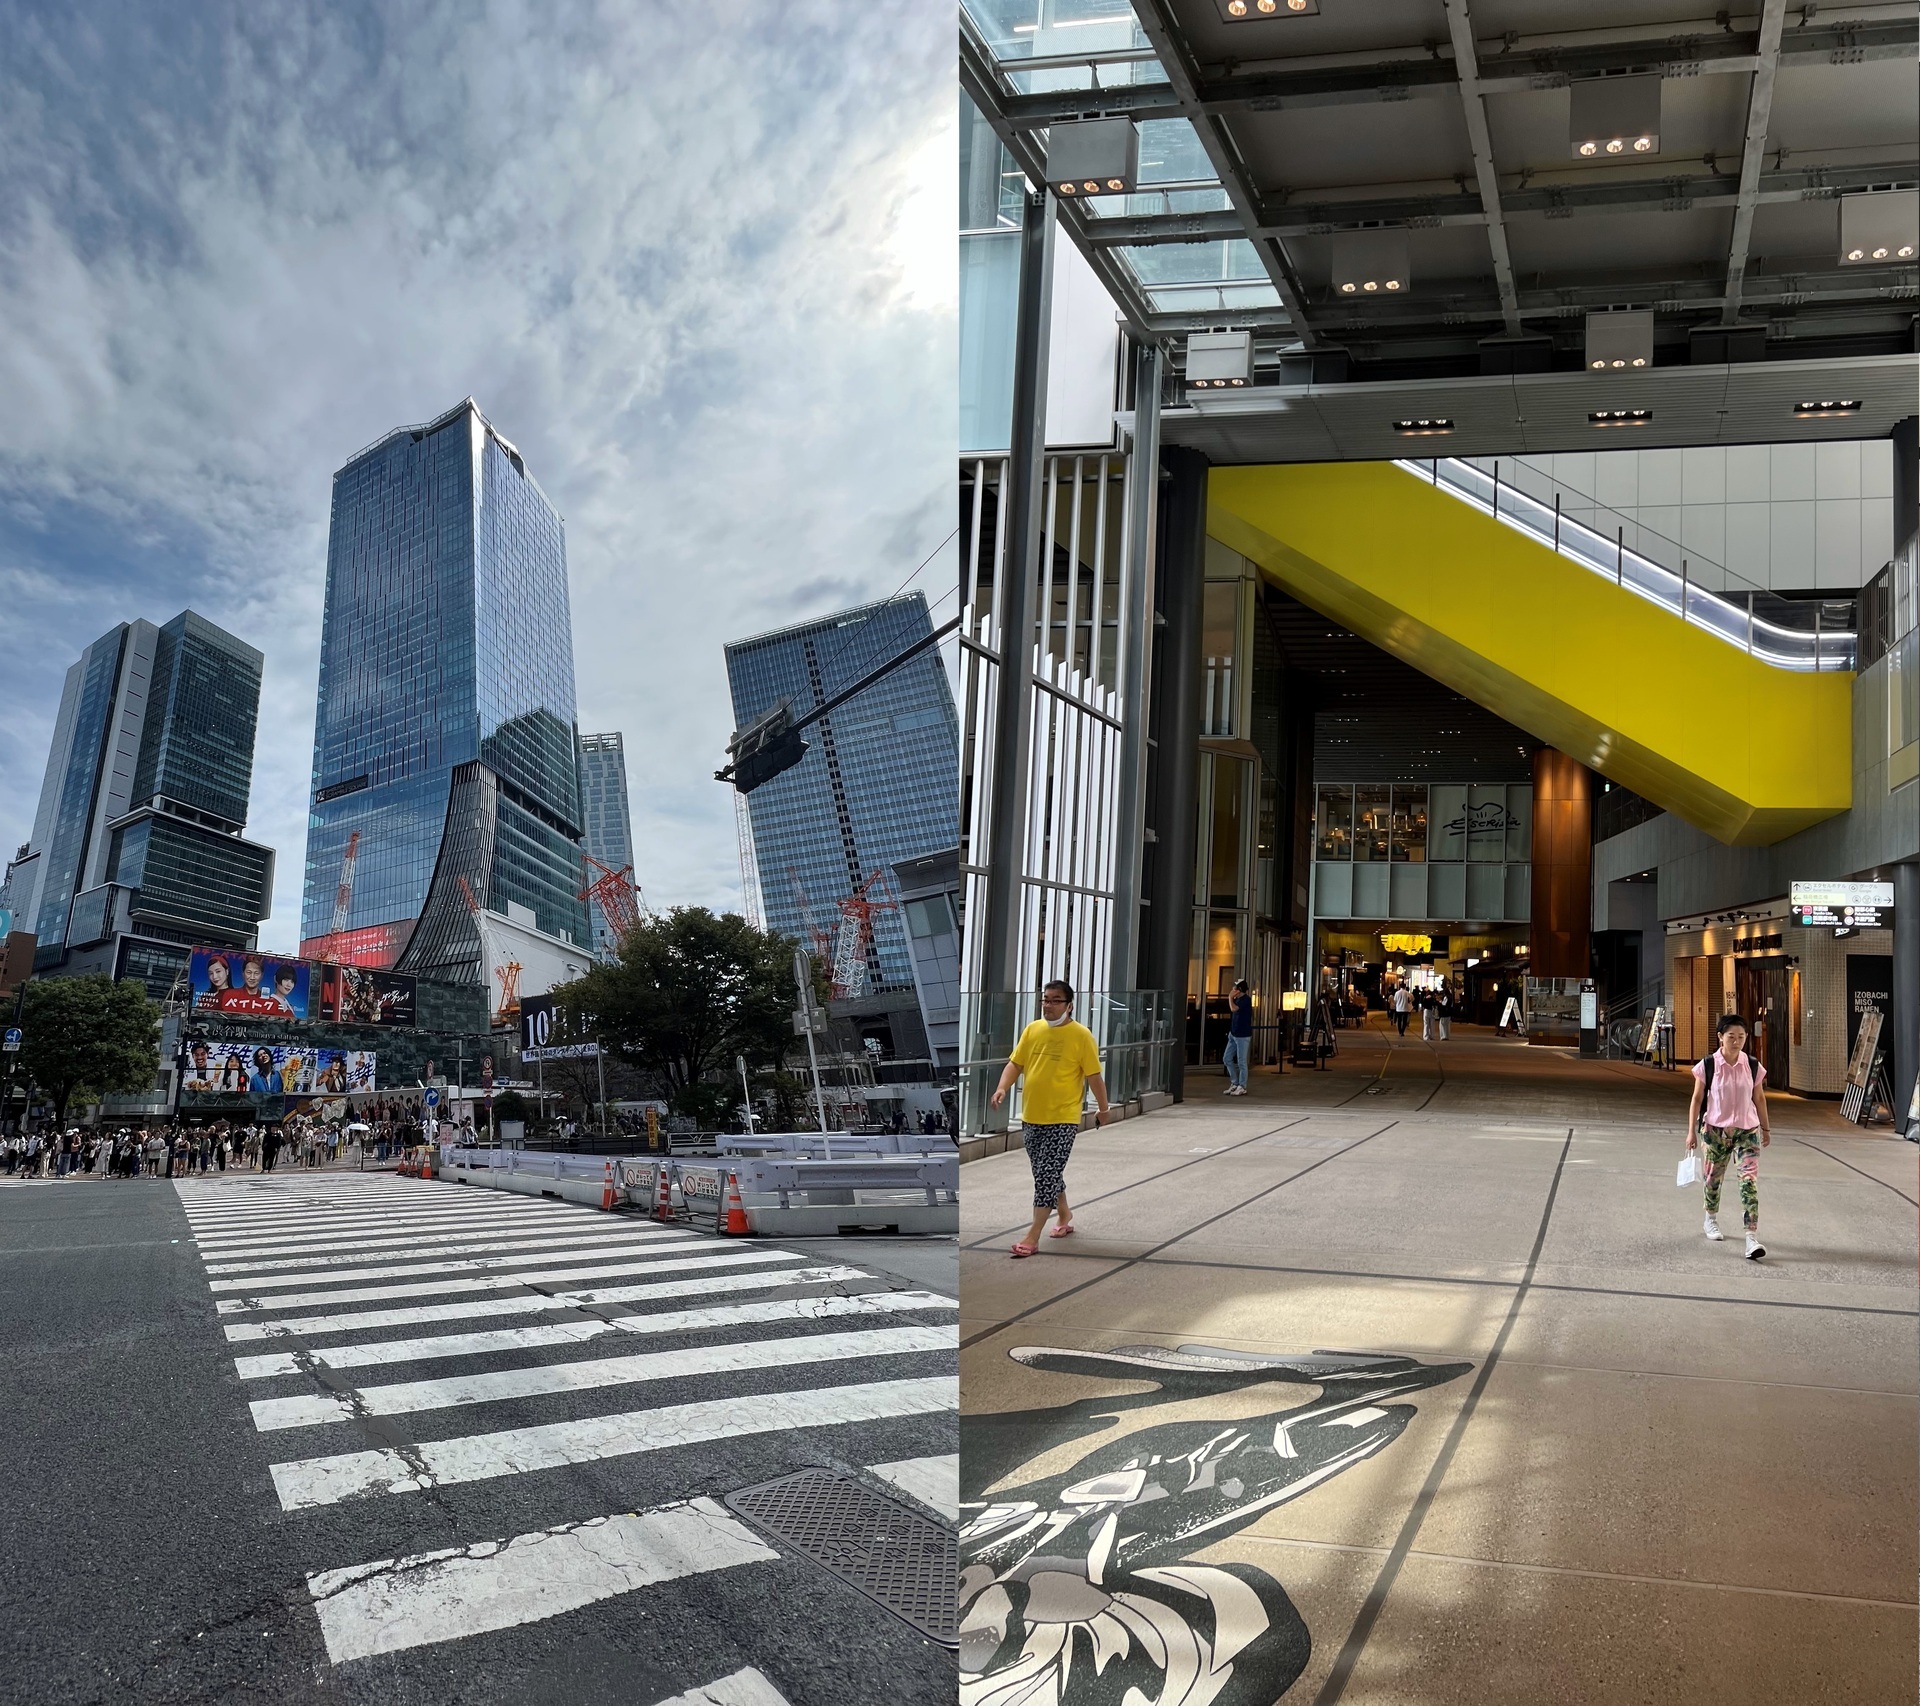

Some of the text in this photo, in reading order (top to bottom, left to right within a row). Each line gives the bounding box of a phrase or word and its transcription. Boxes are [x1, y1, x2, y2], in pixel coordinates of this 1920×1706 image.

[323, 982, 335, 1003] N
[1854, 991, 1888, 999] IZOBACHI
[225, 998, 274, 1011] ペイトク
[1854, 1005, 1880, 1013] RAMEN
[212, 1024, 247, 1038] 渋谷駅
